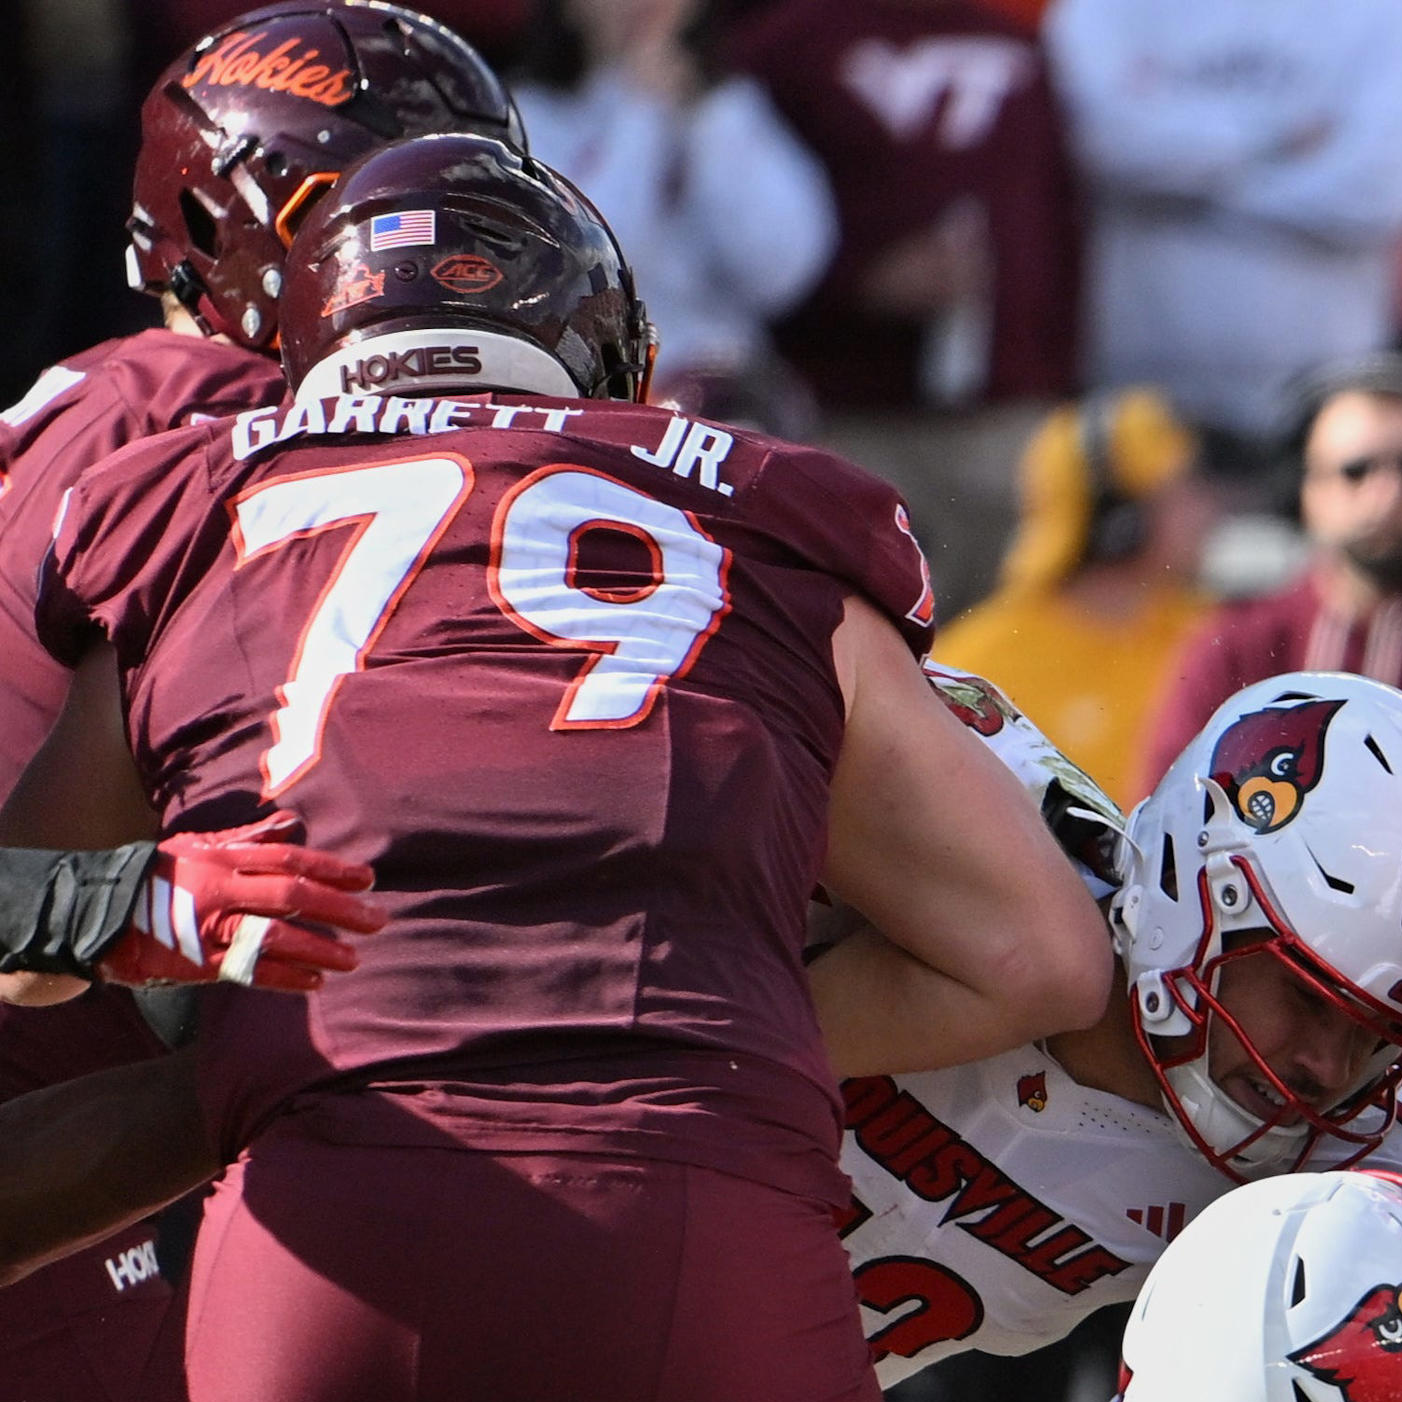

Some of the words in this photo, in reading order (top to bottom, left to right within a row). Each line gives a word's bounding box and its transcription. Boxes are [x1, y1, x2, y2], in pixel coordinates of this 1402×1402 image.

[182, 31, 353, 107] Hokies
[340, 346, 482, 394] HOKIES
[232, 393, 583, 461] GARRETT
[630, 416, 735, 497] JR.
[226, 451, 734, 804] 79
[840, 1075, 1132, 1297] OUISVILLE
